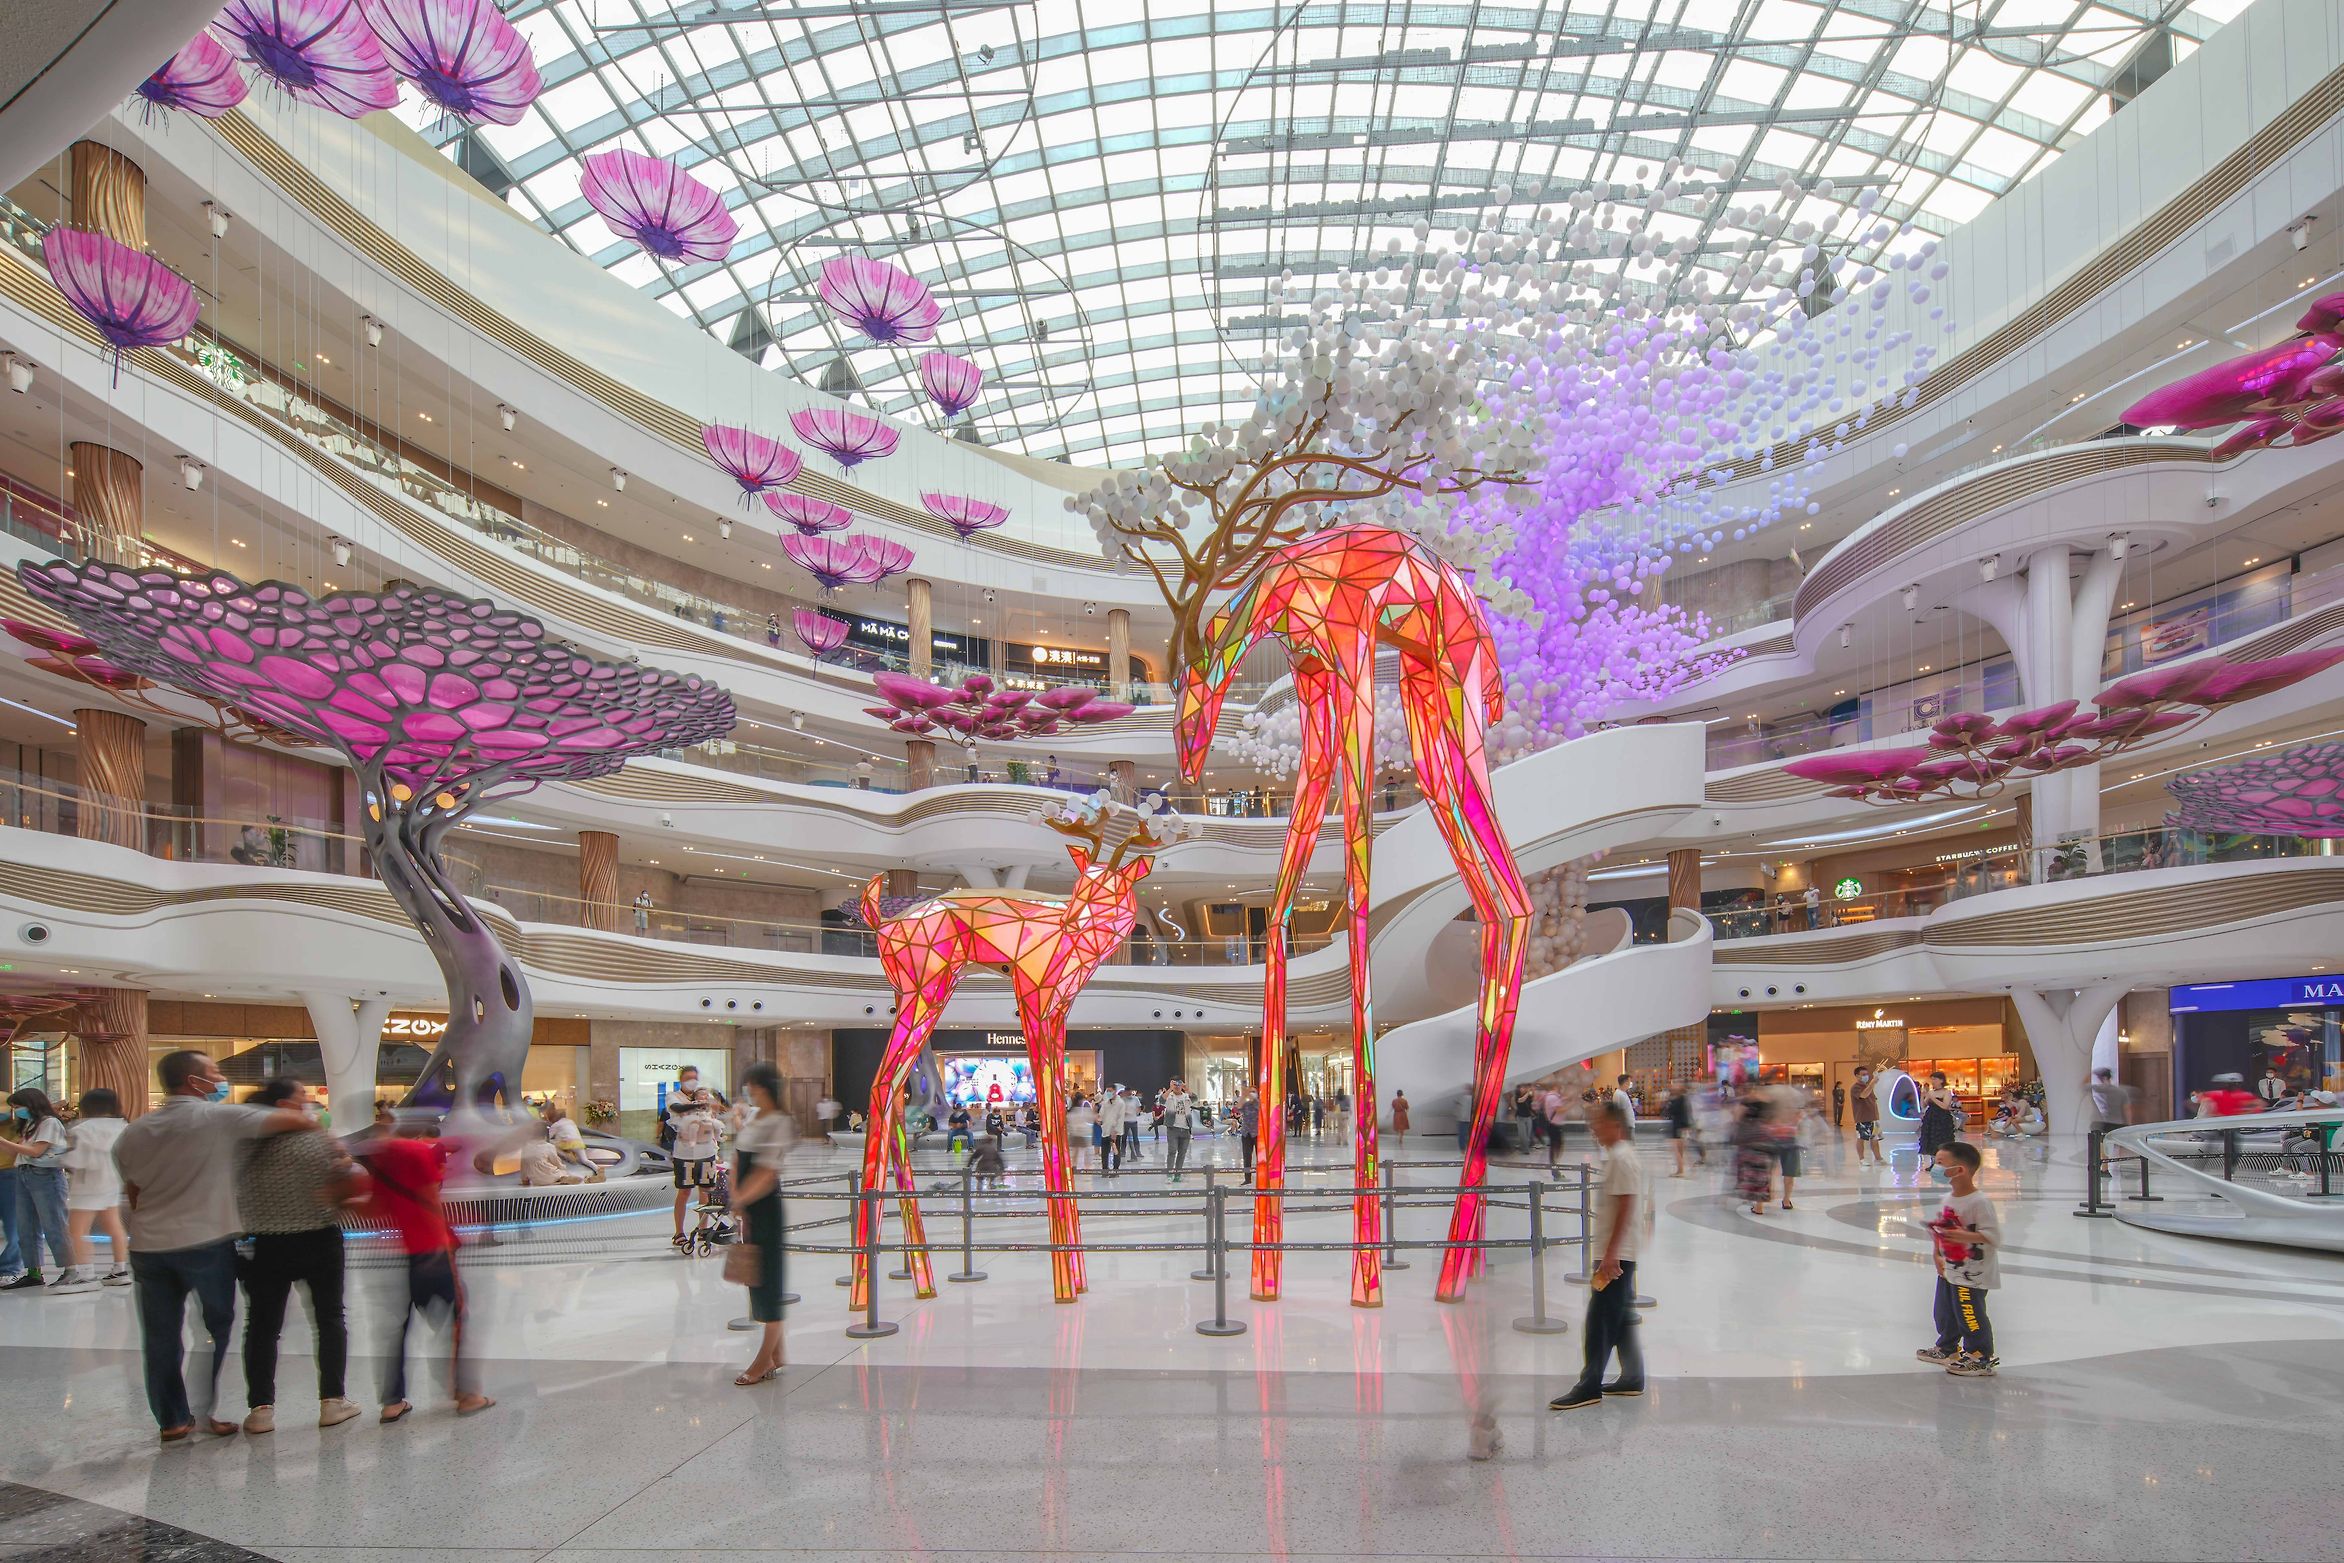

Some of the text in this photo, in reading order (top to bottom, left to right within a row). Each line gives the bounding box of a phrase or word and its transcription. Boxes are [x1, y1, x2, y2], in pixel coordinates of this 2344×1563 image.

[1985, 843, 2018, 855] COFFEE
[987, 1032, 1026, 1045] Hennes
[1957, 1286, 1981, 1333] AUL FRANK
